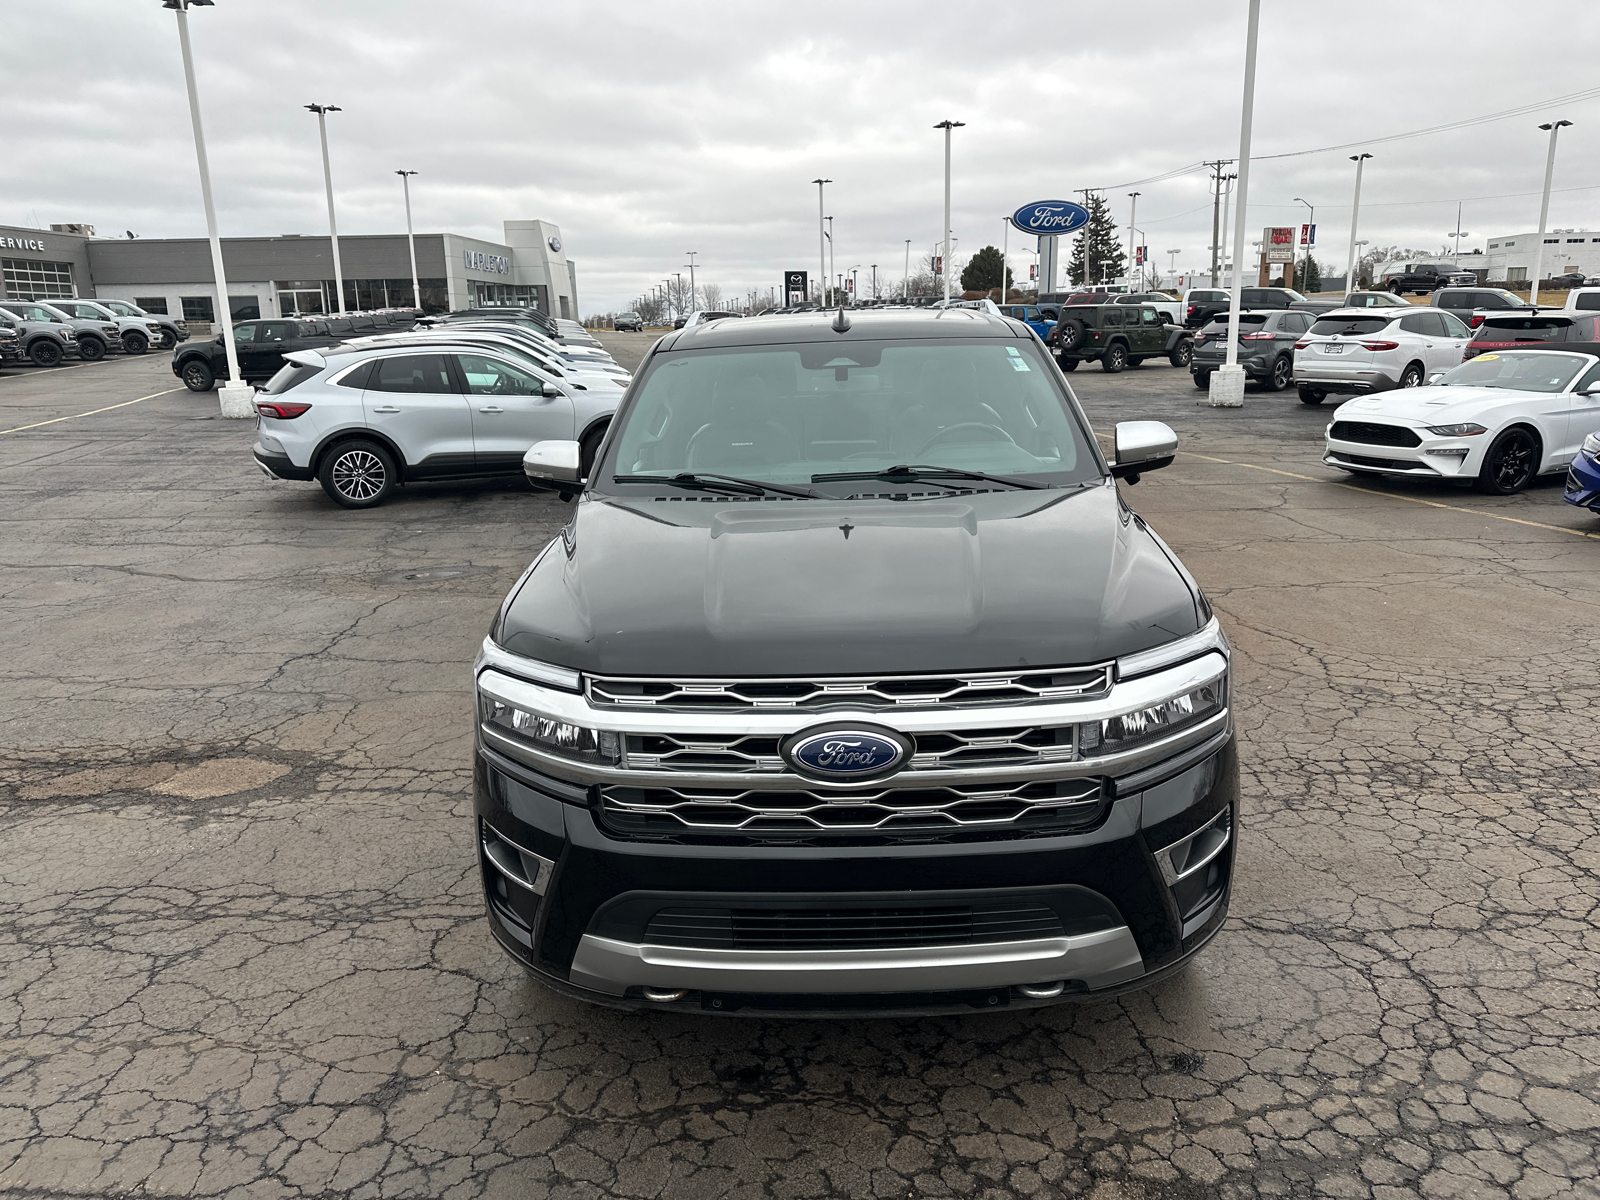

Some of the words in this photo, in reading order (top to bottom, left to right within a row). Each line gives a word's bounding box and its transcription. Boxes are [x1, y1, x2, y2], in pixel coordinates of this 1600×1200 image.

[1029, 206, 1075, 227] Ford
[1271, 228, 1293, 236] FORUM
[464, 249, 510, 275] NAPLETON
[817, 740, 877, 766] Ford
